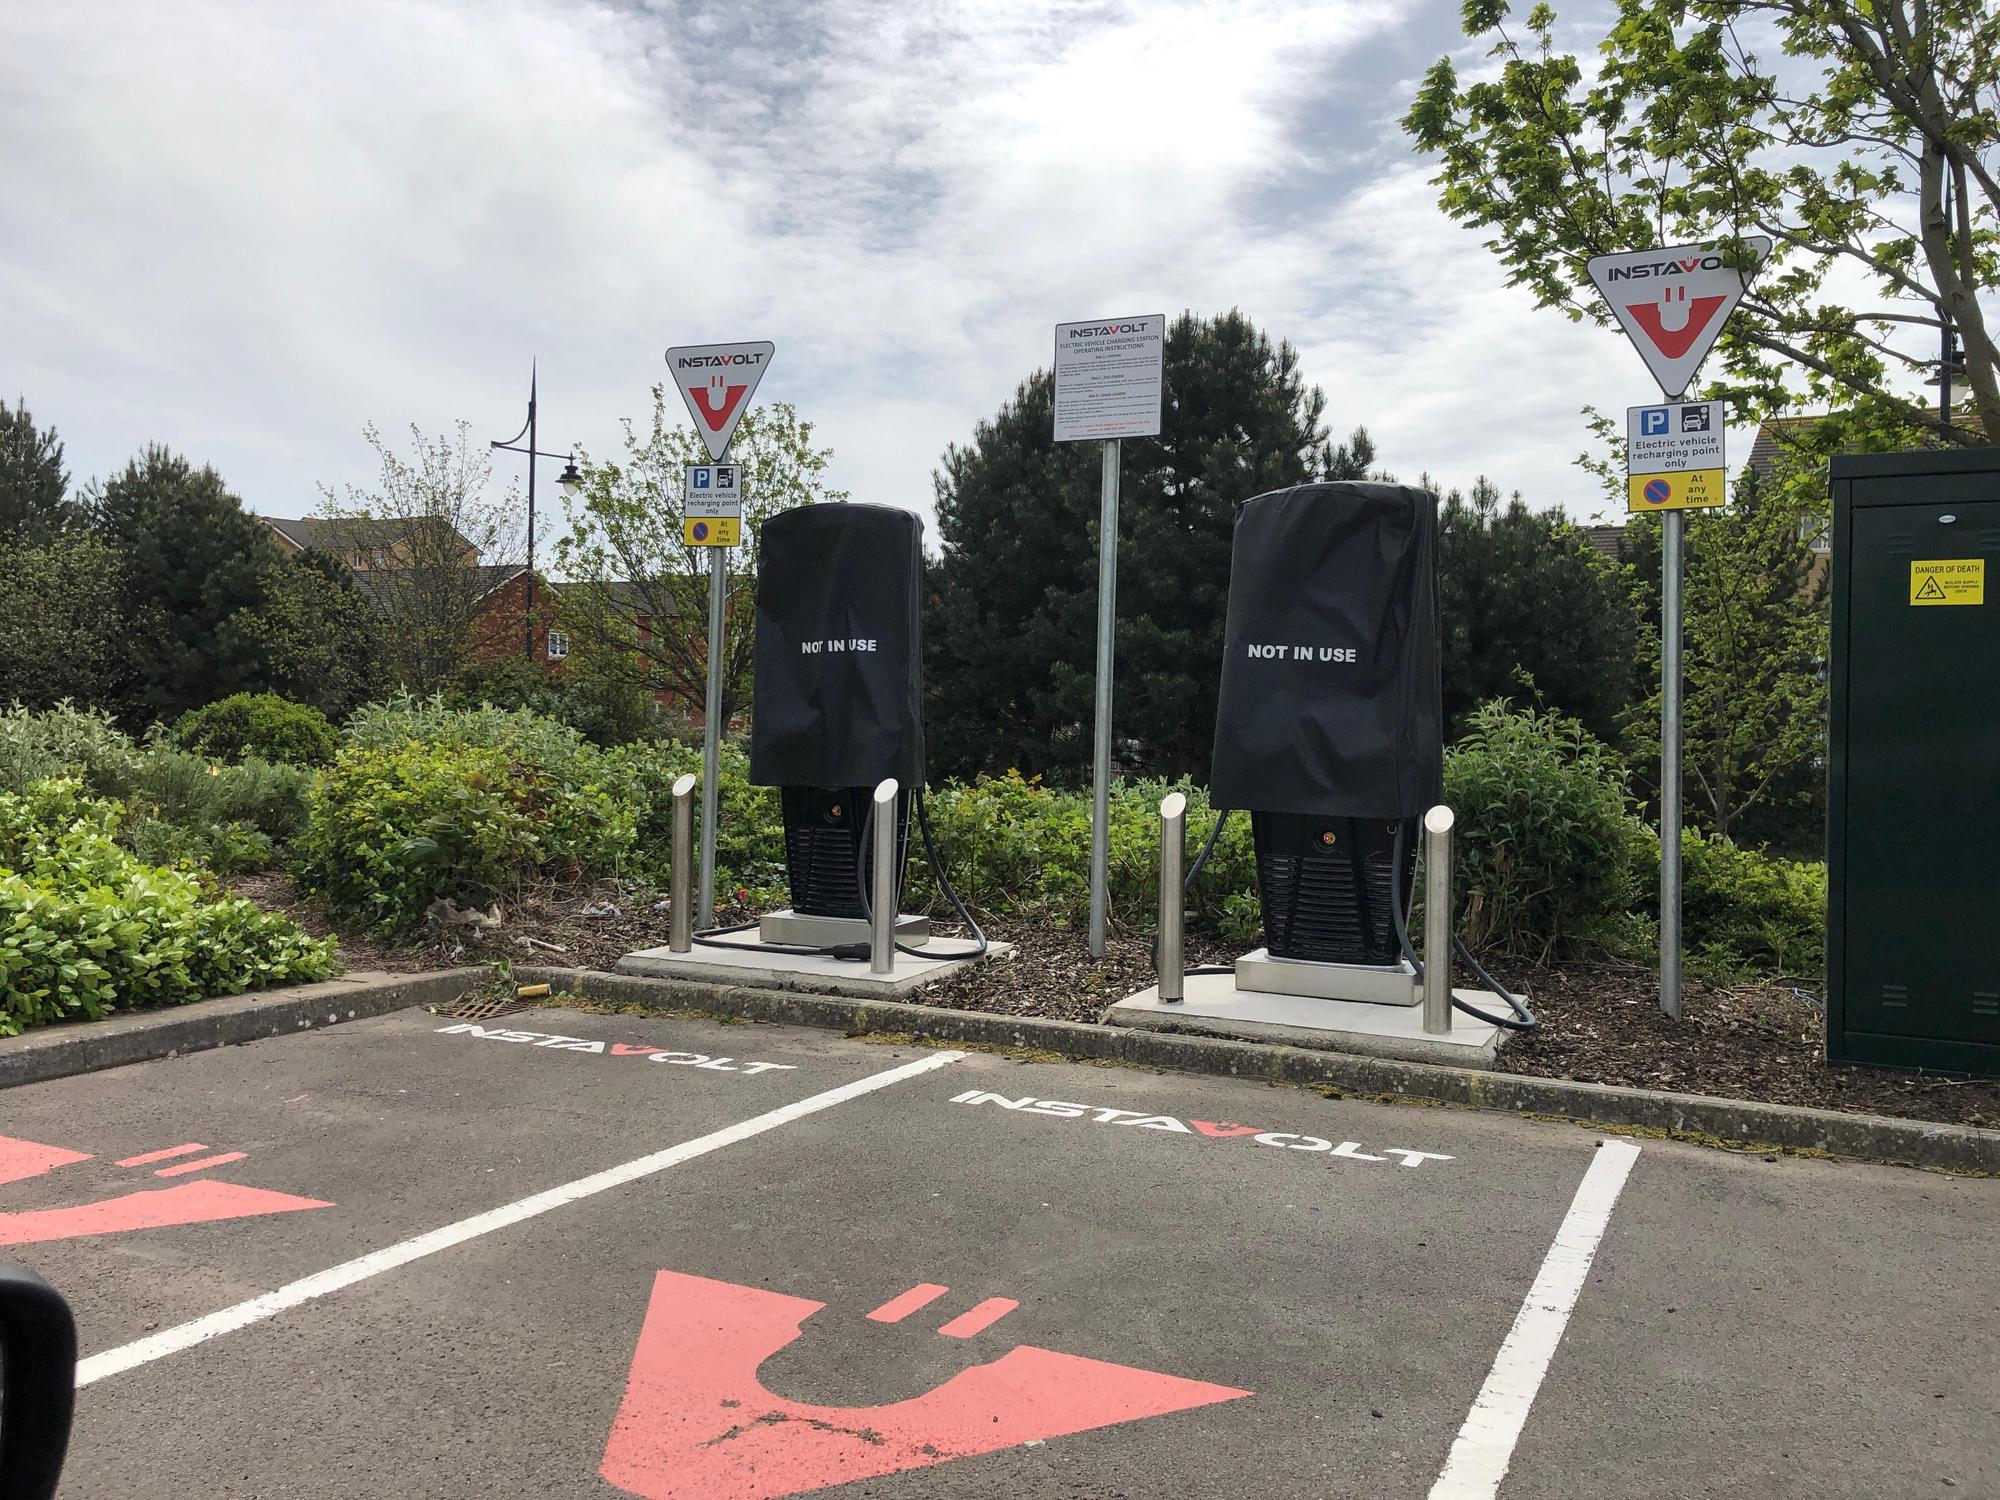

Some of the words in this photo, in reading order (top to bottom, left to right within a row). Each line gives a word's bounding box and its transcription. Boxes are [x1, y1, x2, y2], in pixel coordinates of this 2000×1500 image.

[1608, 256, 1742, 281] INSTAVO
[1070, 323, 1148, 338] INSTAVOLT
[1060, 342, 1083, 350] ELECTRIC
[1106, 337, 1135, 345] CHARGING
[1073, 347, 1104, 355] OPERATING
[1104, 343, 1144, 352] INSTRUCTIONS
[678, 352, 764, 369] INSTAVOLT
[1649, 412, 1665, 431] P
[1635, 438, 1675, 450] Electric
[1679, 436, 1717, 446] vehicle
[1632, 448, 1689, 462] recharging
[1692, 445, 1720, 459] point
[1664, 459, 1687, 469] only
[697, 470, 708, 487] P
[1690, 474, 1703, 483] At
[1687, 486, 1707, 497] any
[721, 499, 738, 507] point
[1685, 495, 1709, 504] time
[1915, 566, 1944, 574] DANGER
[1945, 565, 1955, 573] OF
[1957, 565, 1980, 573] DEATH
[801, 641, 823, 653] NOT
[828, 640, 845, 652] IN
[848, 639, 877, 652] USE
[1248, 644, 1288, 659] NOT
[1293, 646, 1313, 661] IN
[1319, 647, 1357, 663] USE
[434, 1023, 798, 1075] INSTAVOLT
[949, 1089, 1457, 1168] INSTAVOLT
